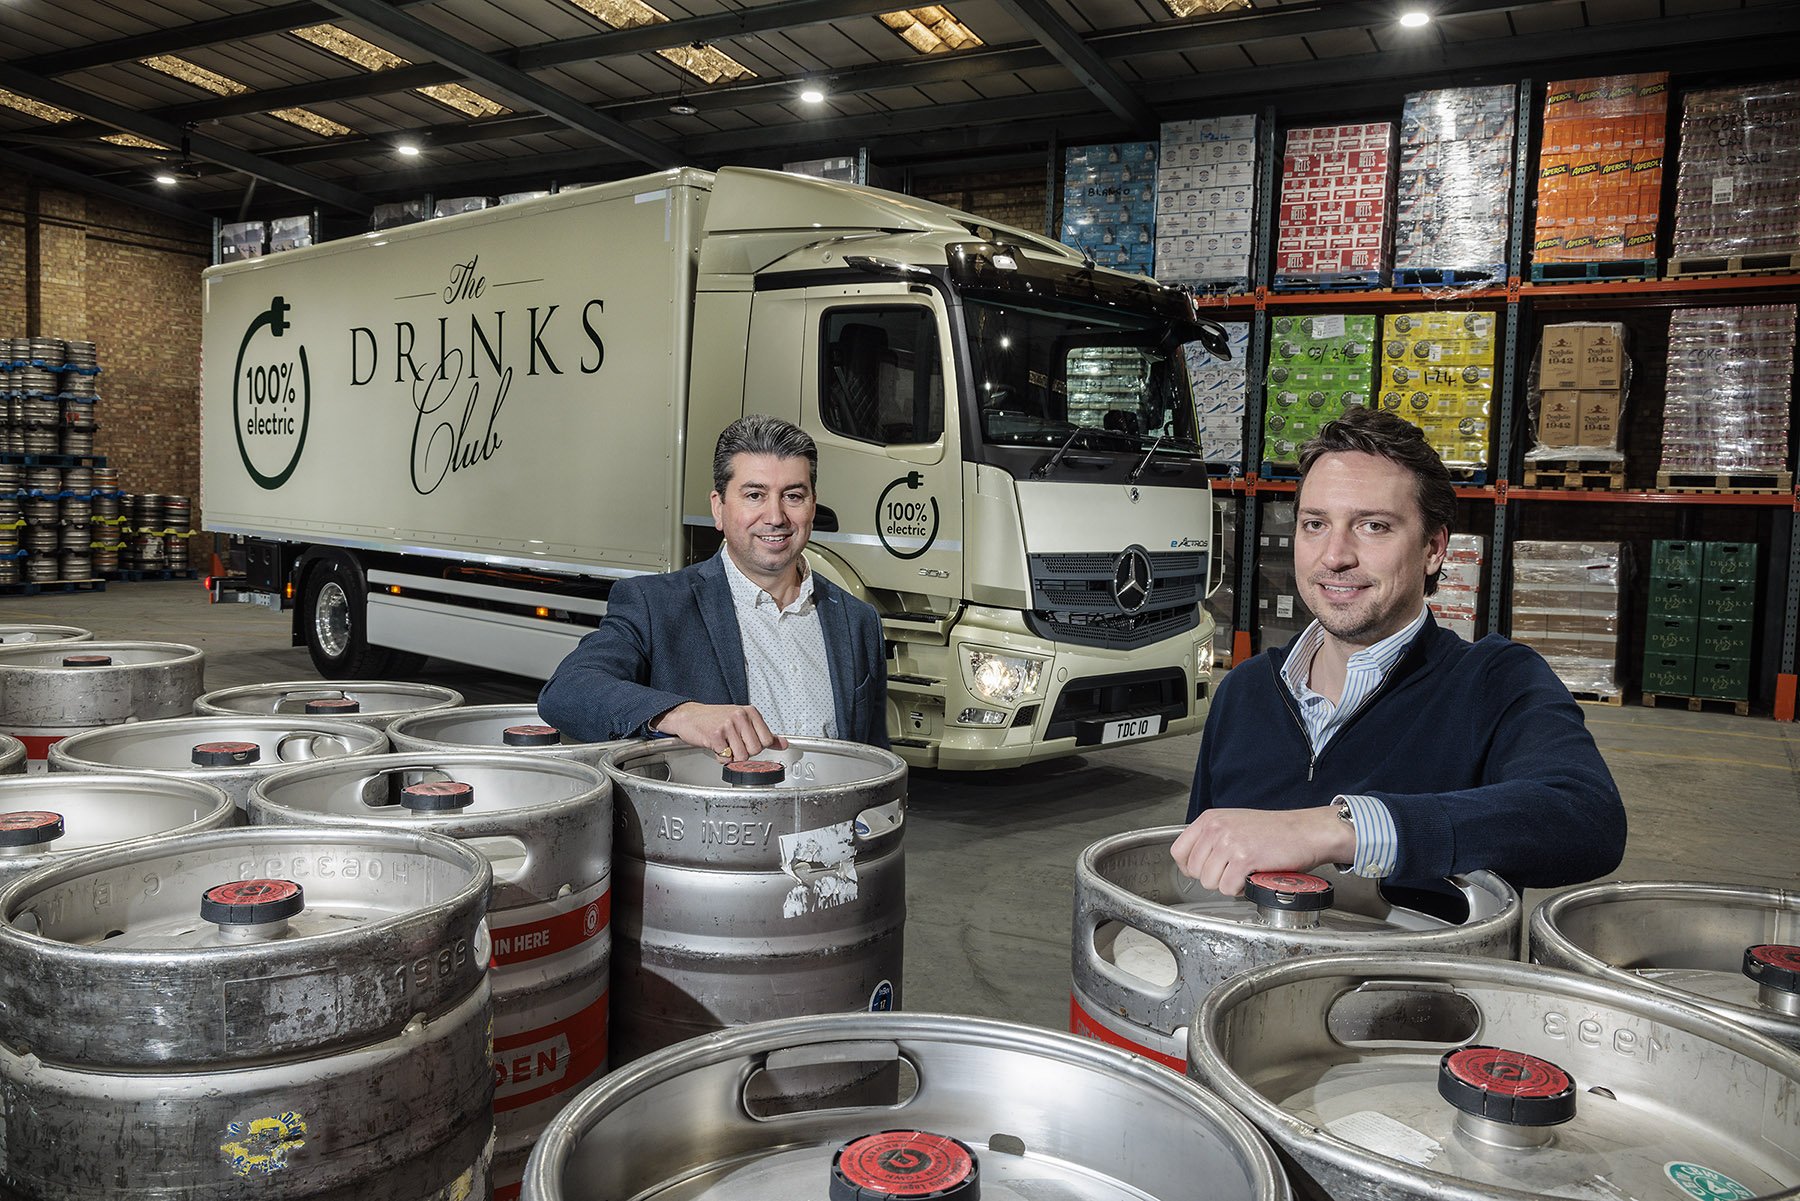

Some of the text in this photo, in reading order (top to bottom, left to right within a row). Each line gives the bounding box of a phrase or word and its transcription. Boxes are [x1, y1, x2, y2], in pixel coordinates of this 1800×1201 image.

[1639, 84, 1665, 96] APEROL
[1548, 93, 1572, 104] APEROL
[1541, 166, 1567, 178] APEROL
[1571, 164, 1597, 176] APEROL
[1602, 162, 1628, 174] APEROL
[1633, 159, 1659, 172] APEROL
[1536, 240, 1560, 251] APEROL
[1565, 237, 1590, 249] APEROL
[1595, 236, 1621, 248] APEROL
[1627, 234, 1653, 246] APEROL
[443, 254, 486, 304] The
[350, 299, 604, 386] DRINKS
[246, 362, 296, 406] 100%
[247, 408, 295, 436] electric
[410, 348, 513, 495] Club
[886, 502, 928, 523] 100%
[887, 523, 926, 537] electric
[1117, 721, 1136, 739] TDC
[656, 815, 685, 842] AB
[701, 819, 773, 846] INBEV
[494, 929, 550, 956] IN HERE
